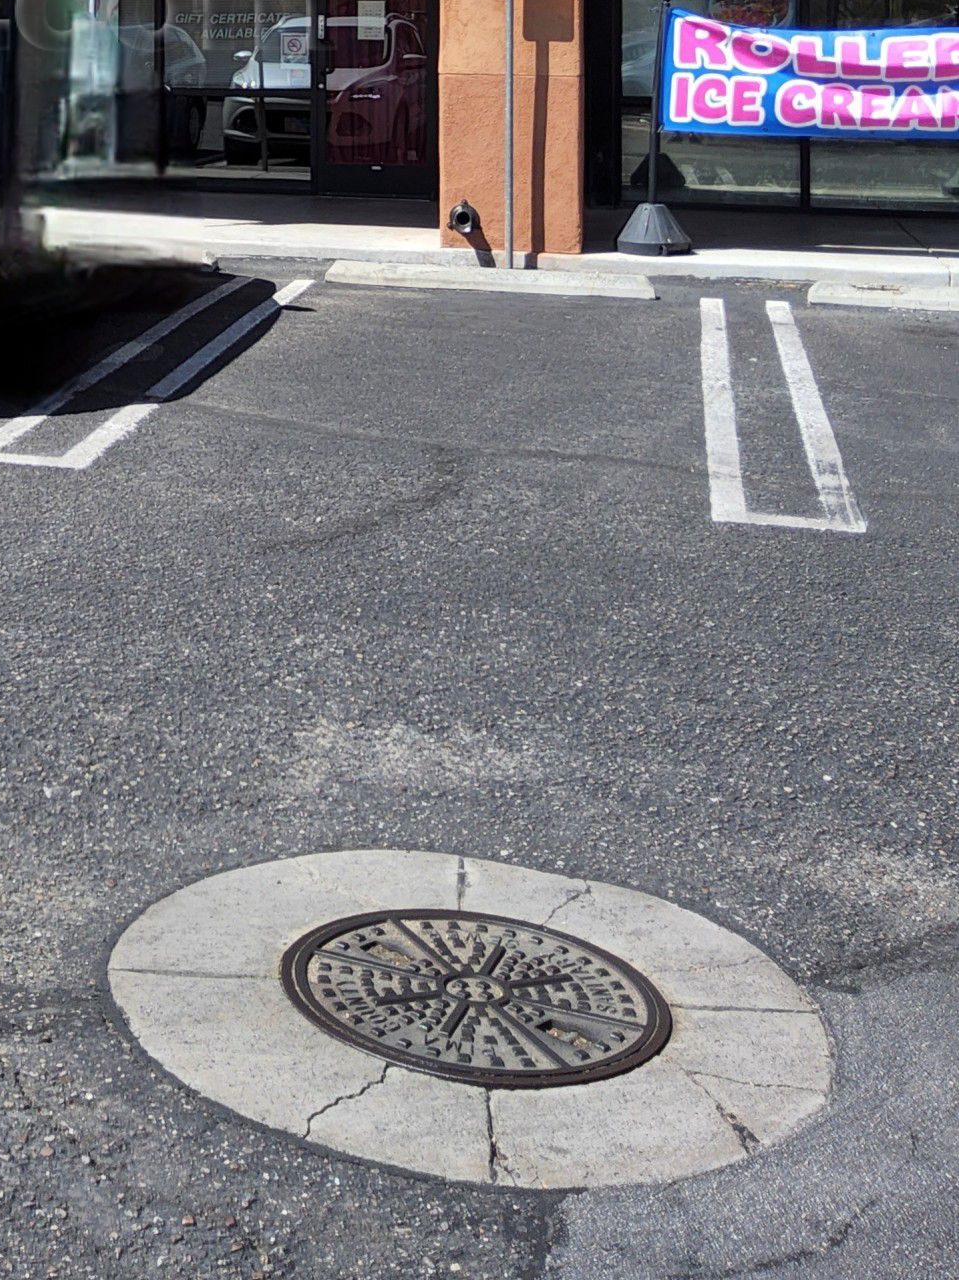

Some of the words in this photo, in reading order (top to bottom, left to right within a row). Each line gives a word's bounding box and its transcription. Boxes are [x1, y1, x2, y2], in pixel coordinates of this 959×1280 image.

[175, 13, 203, 24] GIFT
[201, 27, 271, 40] AVAILABLE
[670, 72, 767, 126] ICE
